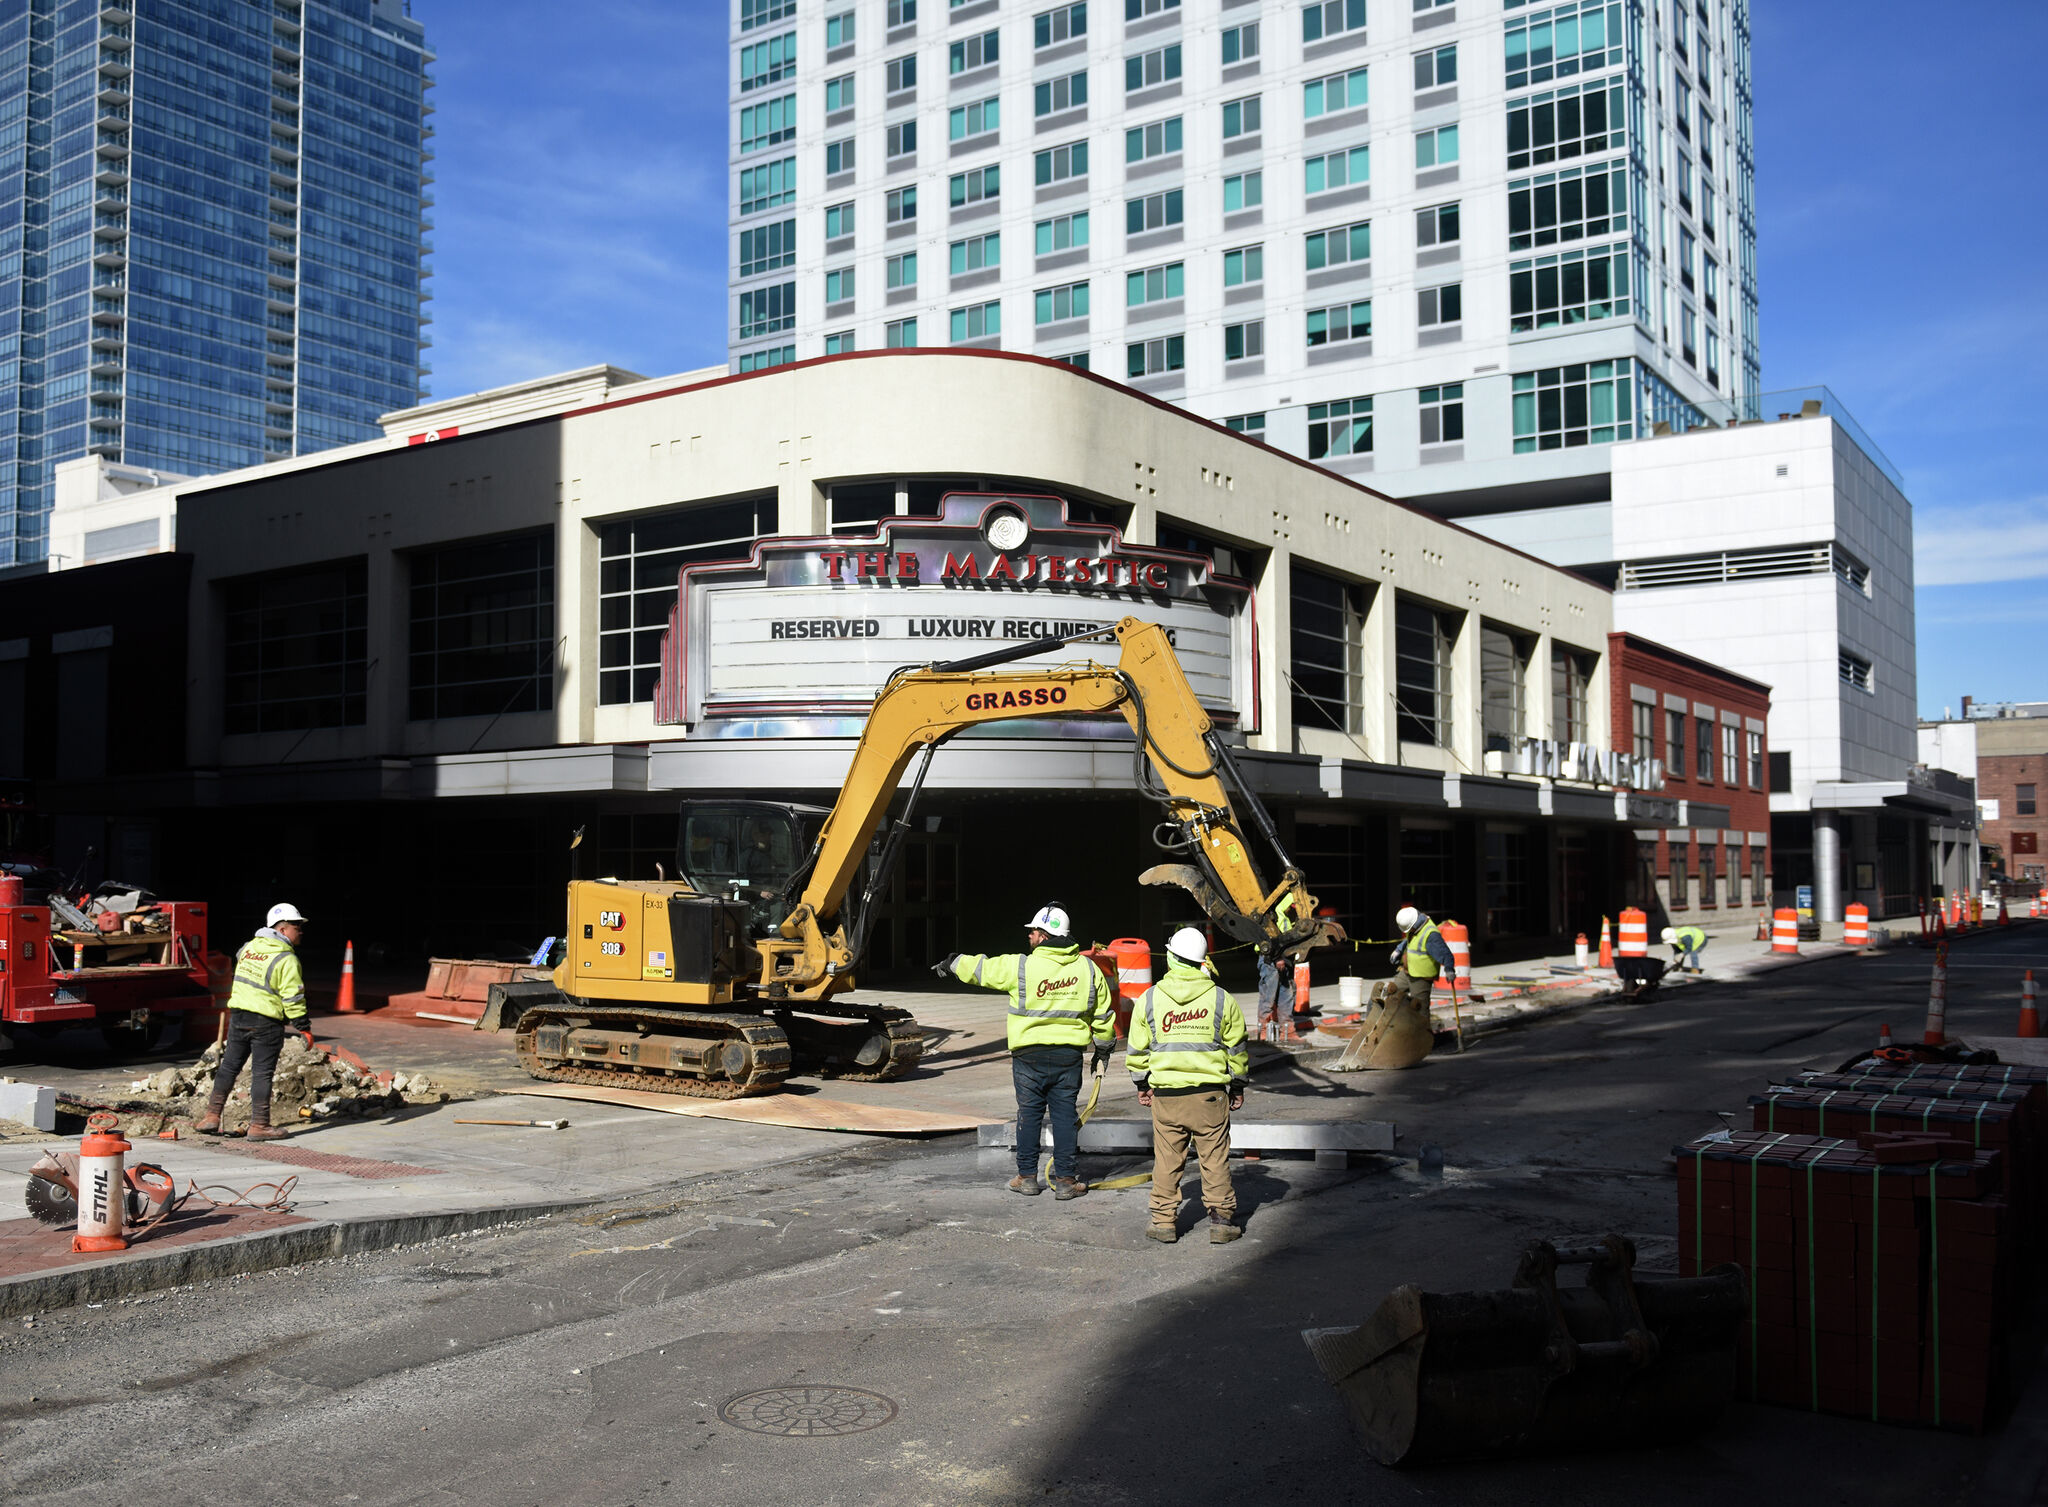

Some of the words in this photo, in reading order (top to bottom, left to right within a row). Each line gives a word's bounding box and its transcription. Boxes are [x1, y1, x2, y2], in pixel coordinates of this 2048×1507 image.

[820, 551, 917, 579] THE
[942, 551, 1168, 589] MAJESTIC
[771, 619, 880, 639] RESERVED
[908, 618, 996, 638] LUXURY
[966, 686, 1067, 711] GRASSO
[645, 900, 663, 910] EX-33
[600, 911, 620, 928] CAT
[601, 942, 621, 955] 308
[1036, 976, 1079, 998] Grasso
[1162, 1008, 1208, 1033] Grasso
[93, 1170, 108, 1225] STIHL
